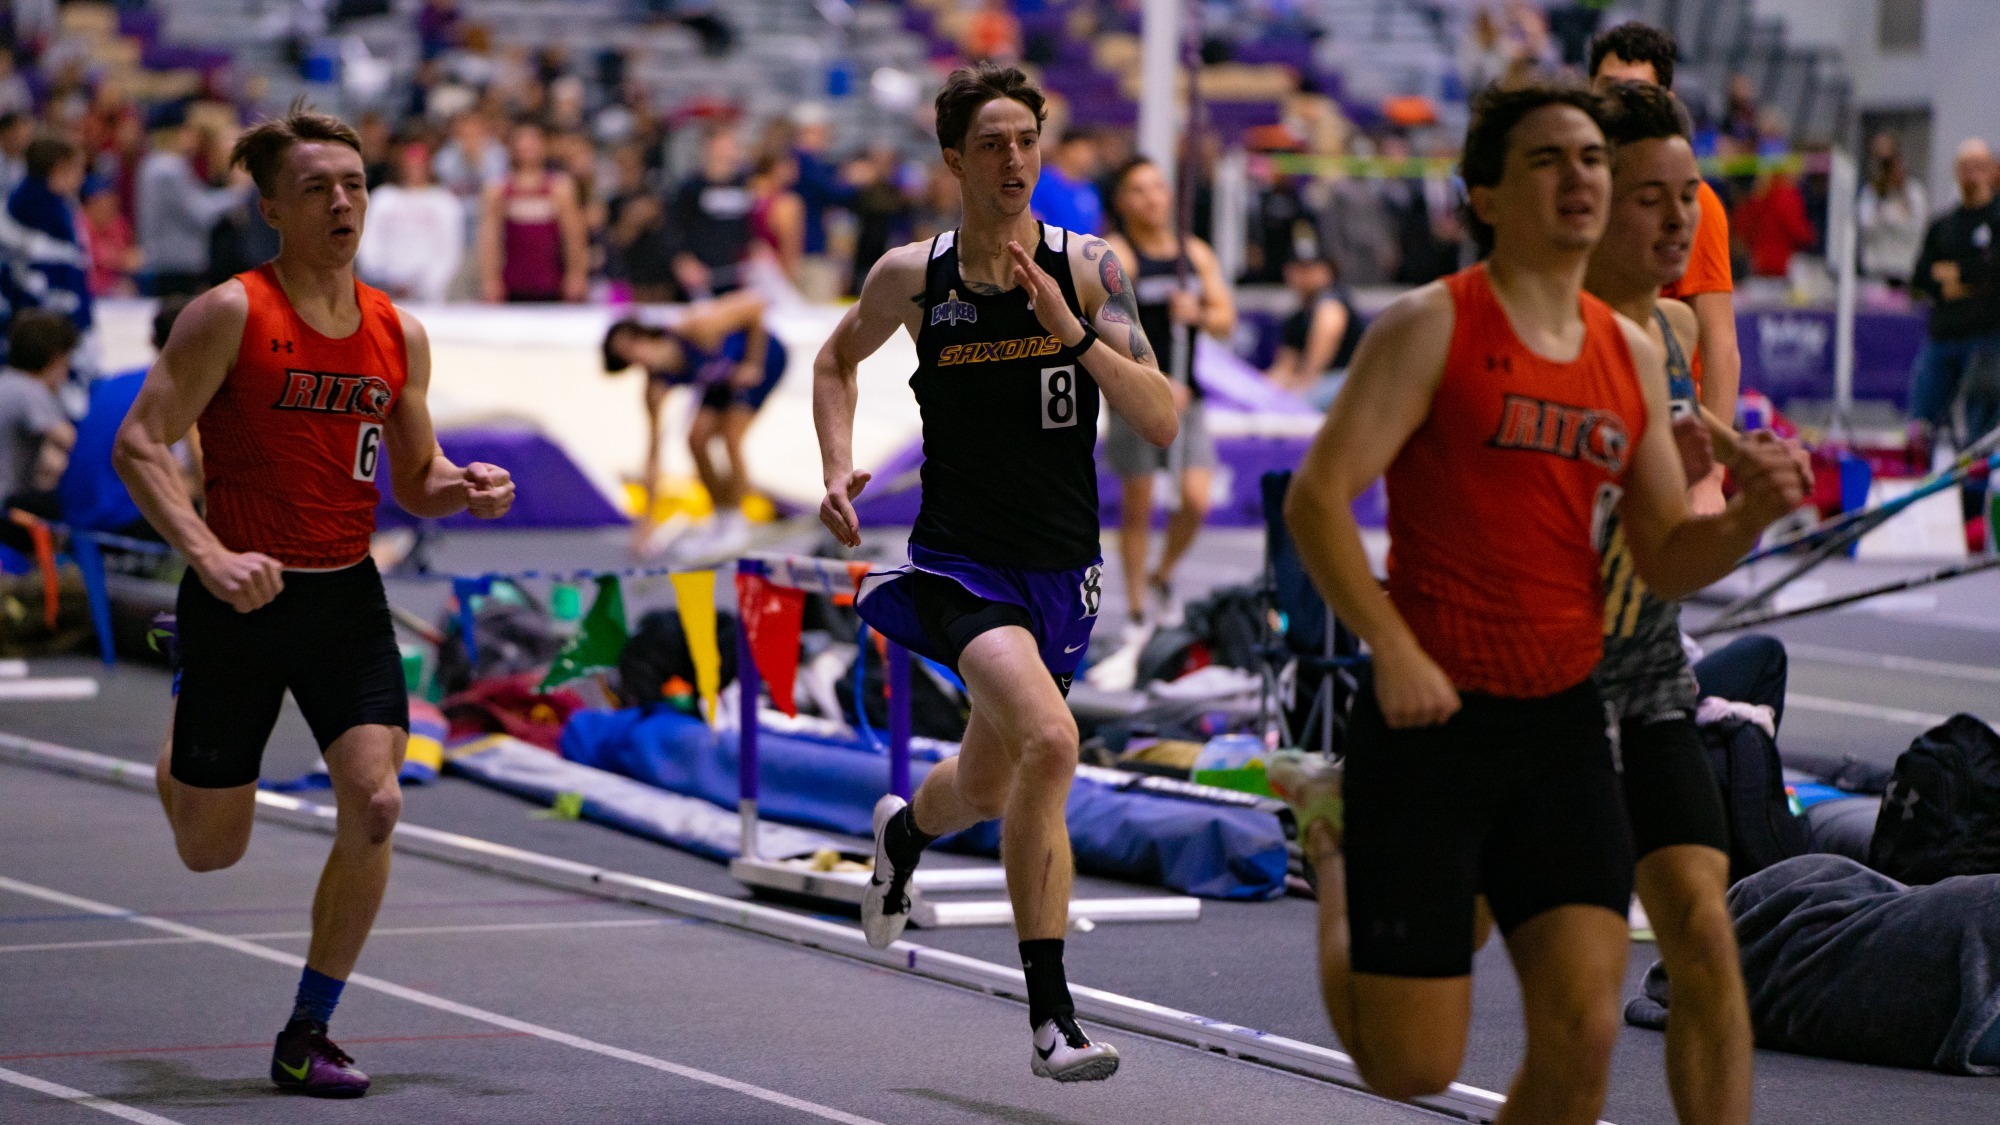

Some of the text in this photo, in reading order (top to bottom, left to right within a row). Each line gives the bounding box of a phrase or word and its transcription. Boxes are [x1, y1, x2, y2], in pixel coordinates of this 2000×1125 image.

[938, 335, 1062, 366] SAXONS
[276, 370, 359, 413] RIT
[1048, 370, 1074, 423] 8
[1498, 396, 1586, 457] RIT
[359, 427, 379, 477] 6
[1083, 566, 1101, 615] 8
